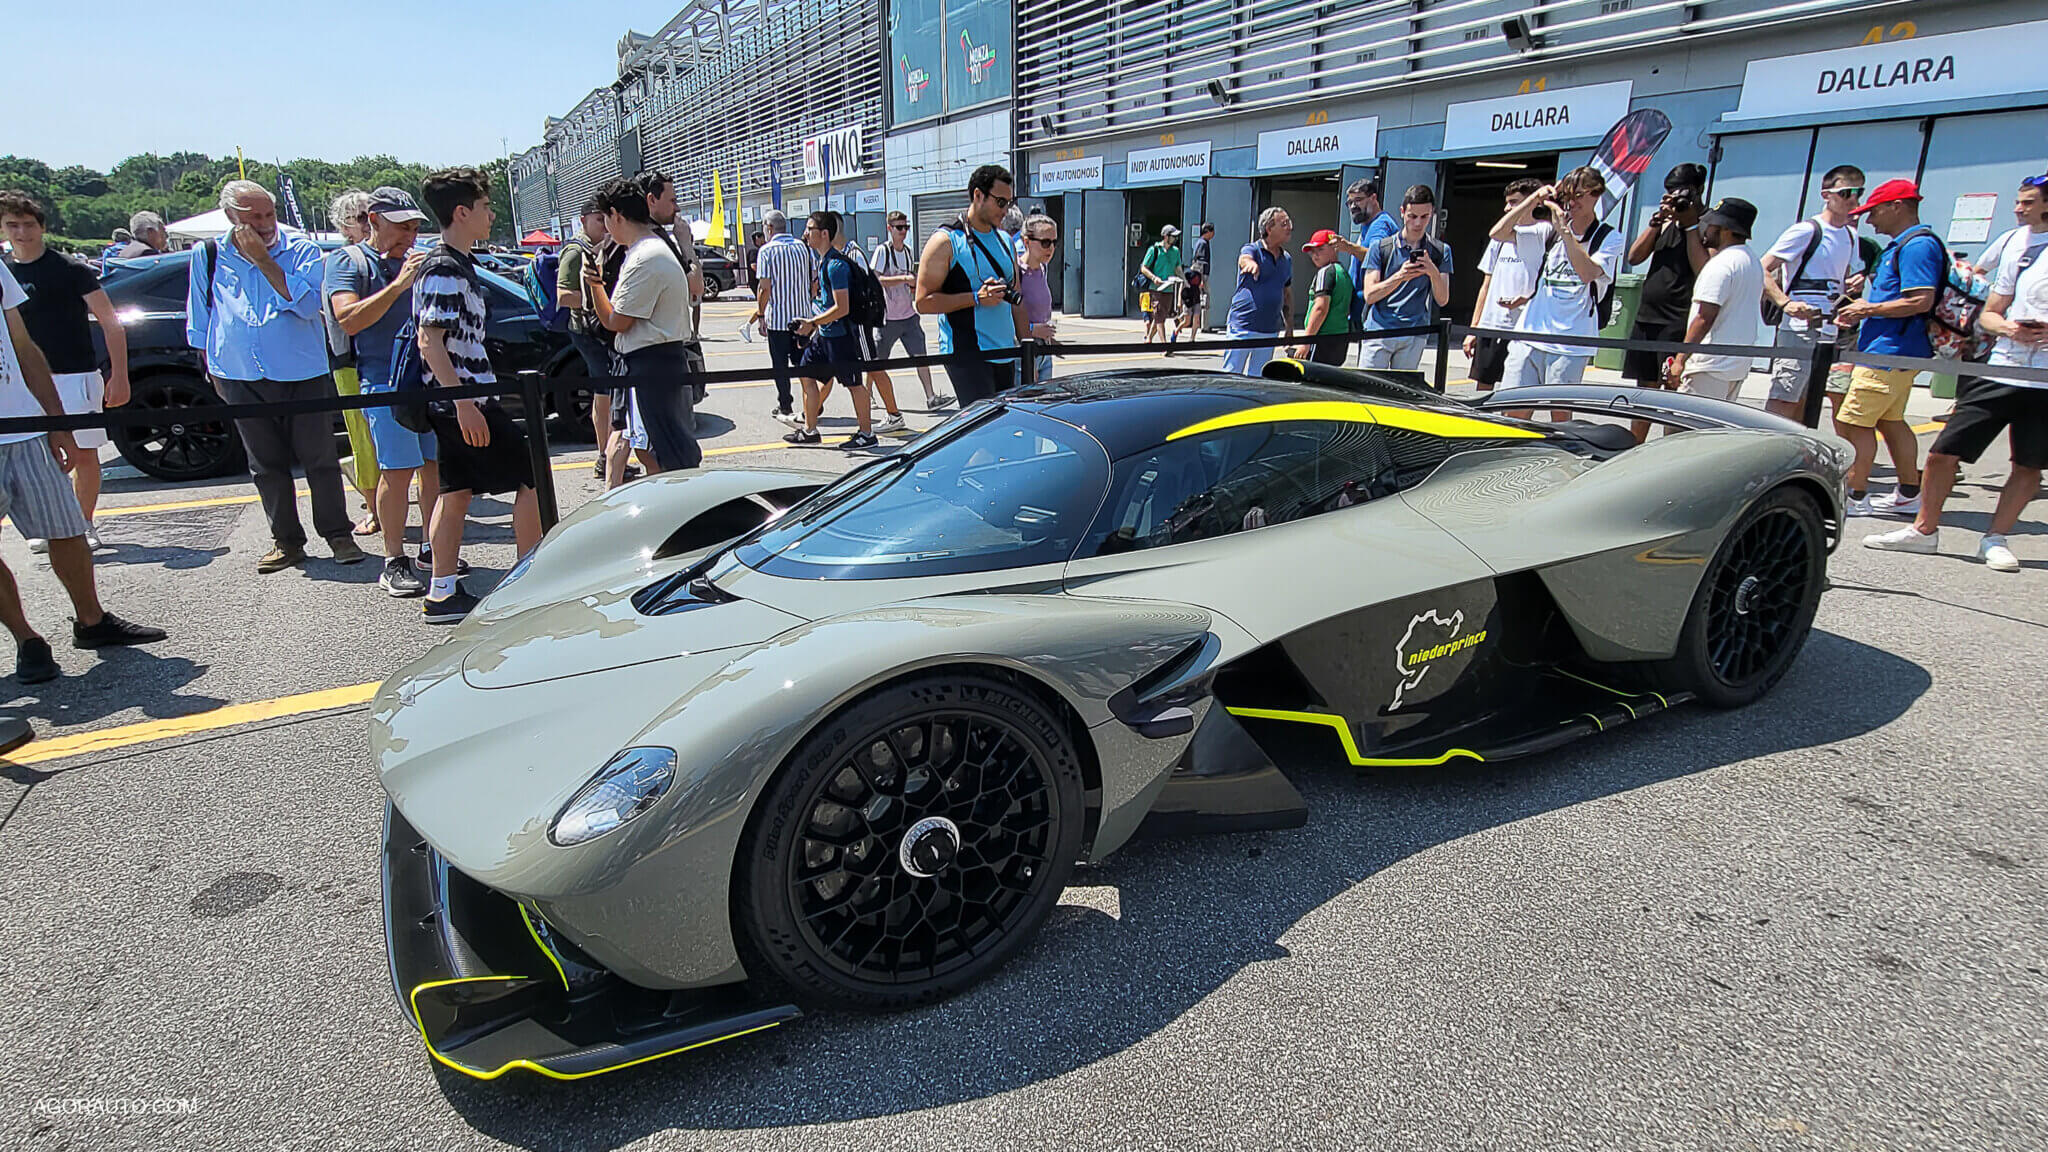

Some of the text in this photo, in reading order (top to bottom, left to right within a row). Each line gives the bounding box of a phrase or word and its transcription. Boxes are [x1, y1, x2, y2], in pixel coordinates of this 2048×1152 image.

[968, 44, 990, 63] MONZA
[1817, 55, 1955, 94] DALLARA
[1491, 105, 1570, 132] DALLARA
[1287, 135, 1340, 156] DALLARA
[1042, 166, 1099, 182] INDY AUTONOMOUS
[1131, 153, 1205, 173] INDY AUTONOMOUS
[1408, 630, 1487, 666] niederprince
[984, 689, 1061, 750] MICHELIN
